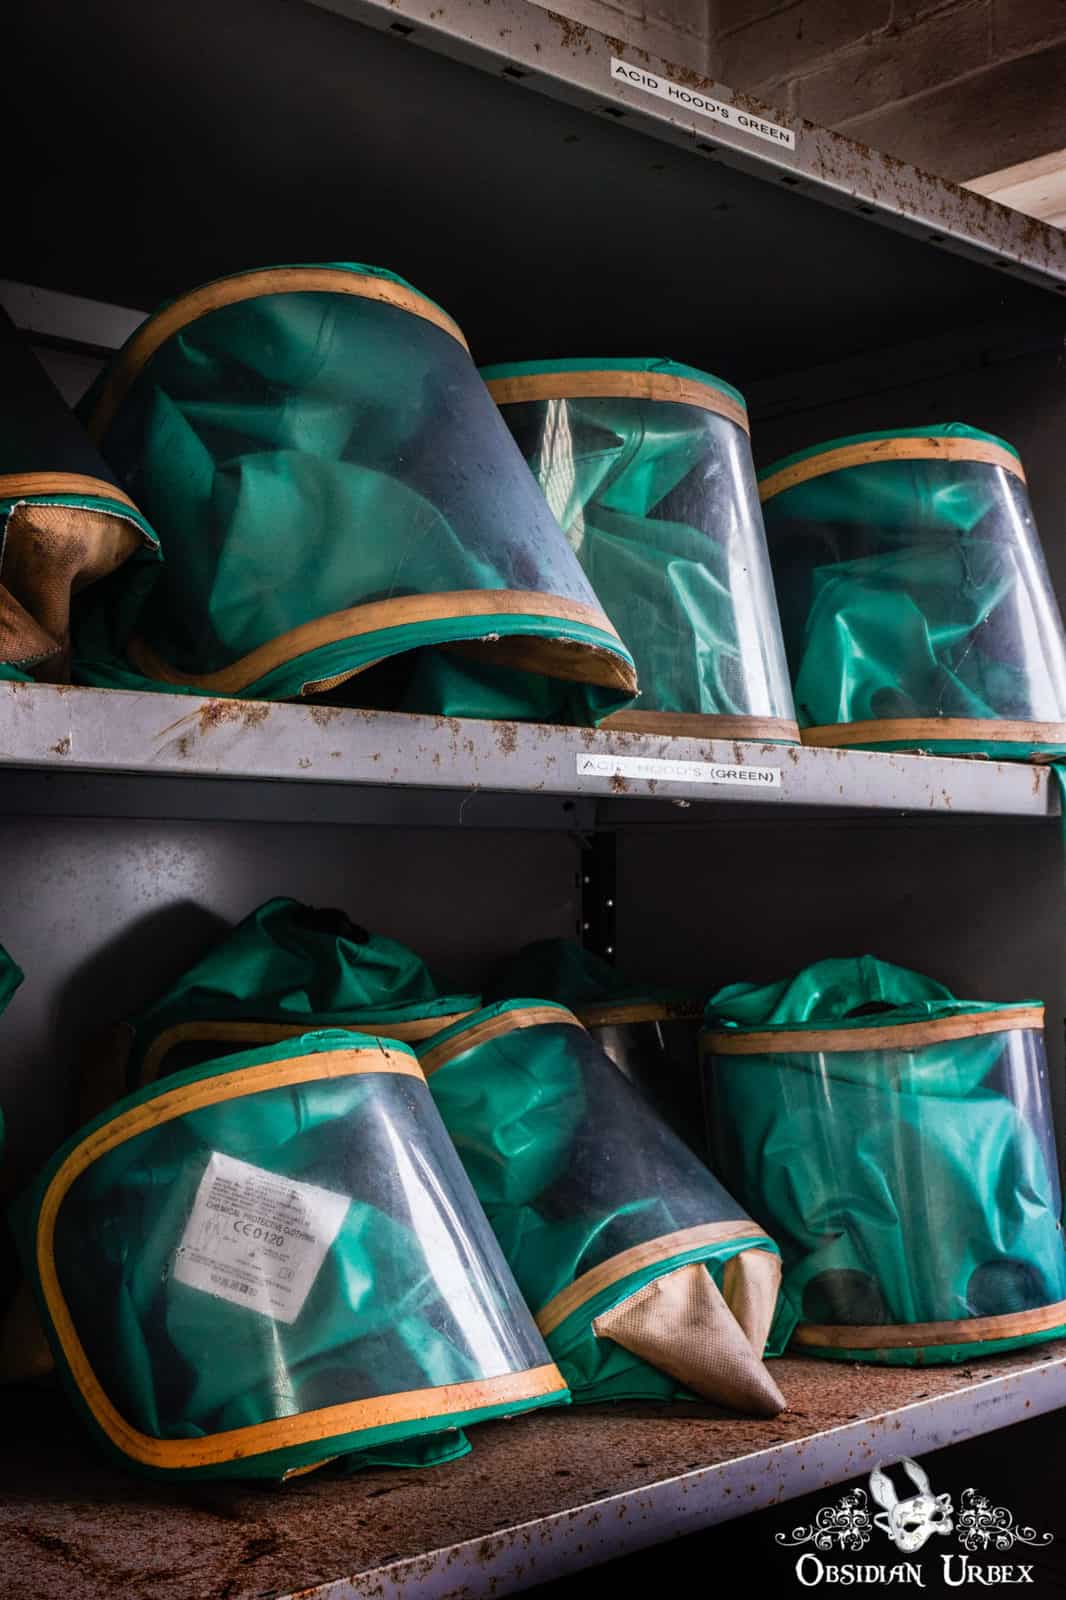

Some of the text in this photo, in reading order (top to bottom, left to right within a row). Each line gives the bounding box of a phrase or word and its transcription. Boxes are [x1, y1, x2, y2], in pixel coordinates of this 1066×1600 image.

[616, 66, 790, 142] ACID HOOD'S GREEN
[711, 768, 774, 783] (GREEN)
